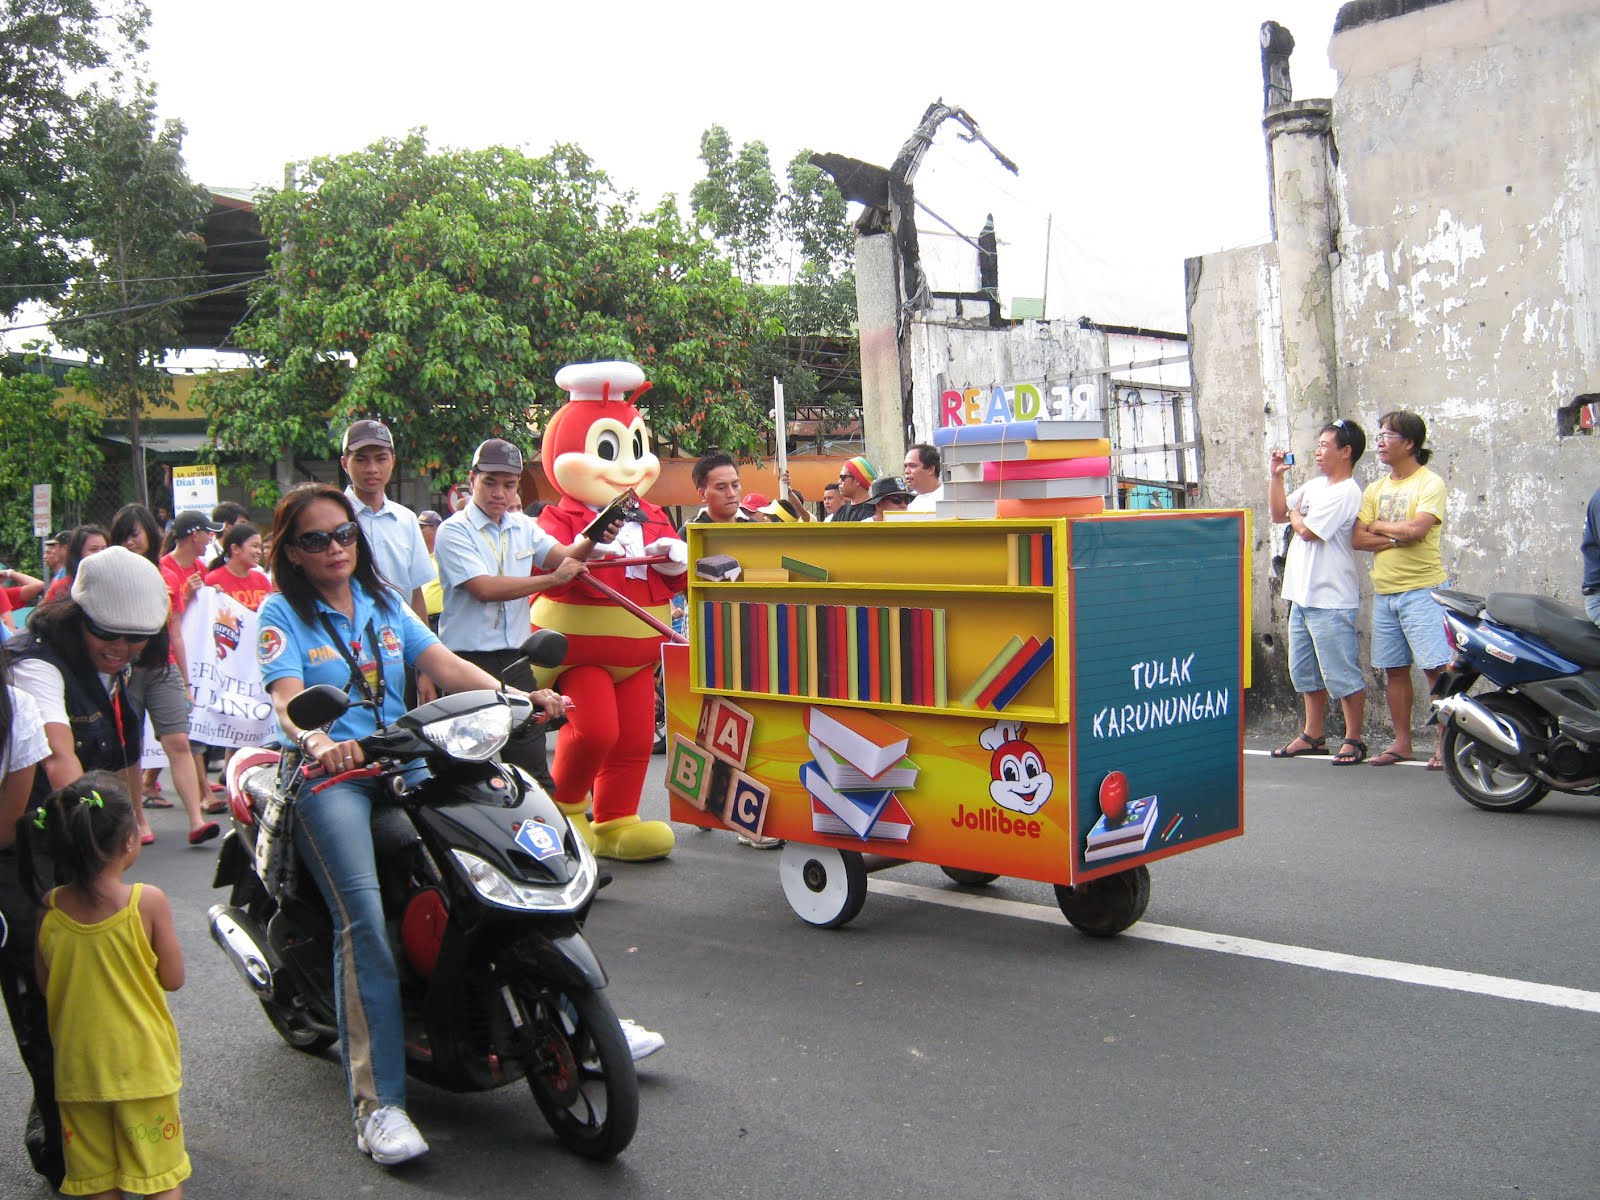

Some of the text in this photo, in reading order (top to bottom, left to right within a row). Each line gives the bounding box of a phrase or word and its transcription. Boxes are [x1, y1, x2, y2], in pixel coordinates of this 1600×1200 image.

[942, 383, 1040, 428] READ
[176, 478, 195, 486] Dial
[1131, 652, 1195, 690] TULAK
[1093, 687, 1228, 738] KARUNUNGAN
[717, 717, 739, 754] A
[675, 751, 698, 789] B
[738, 791, 758, 824] C
[950, 803, 1041, 838] Jollibee
